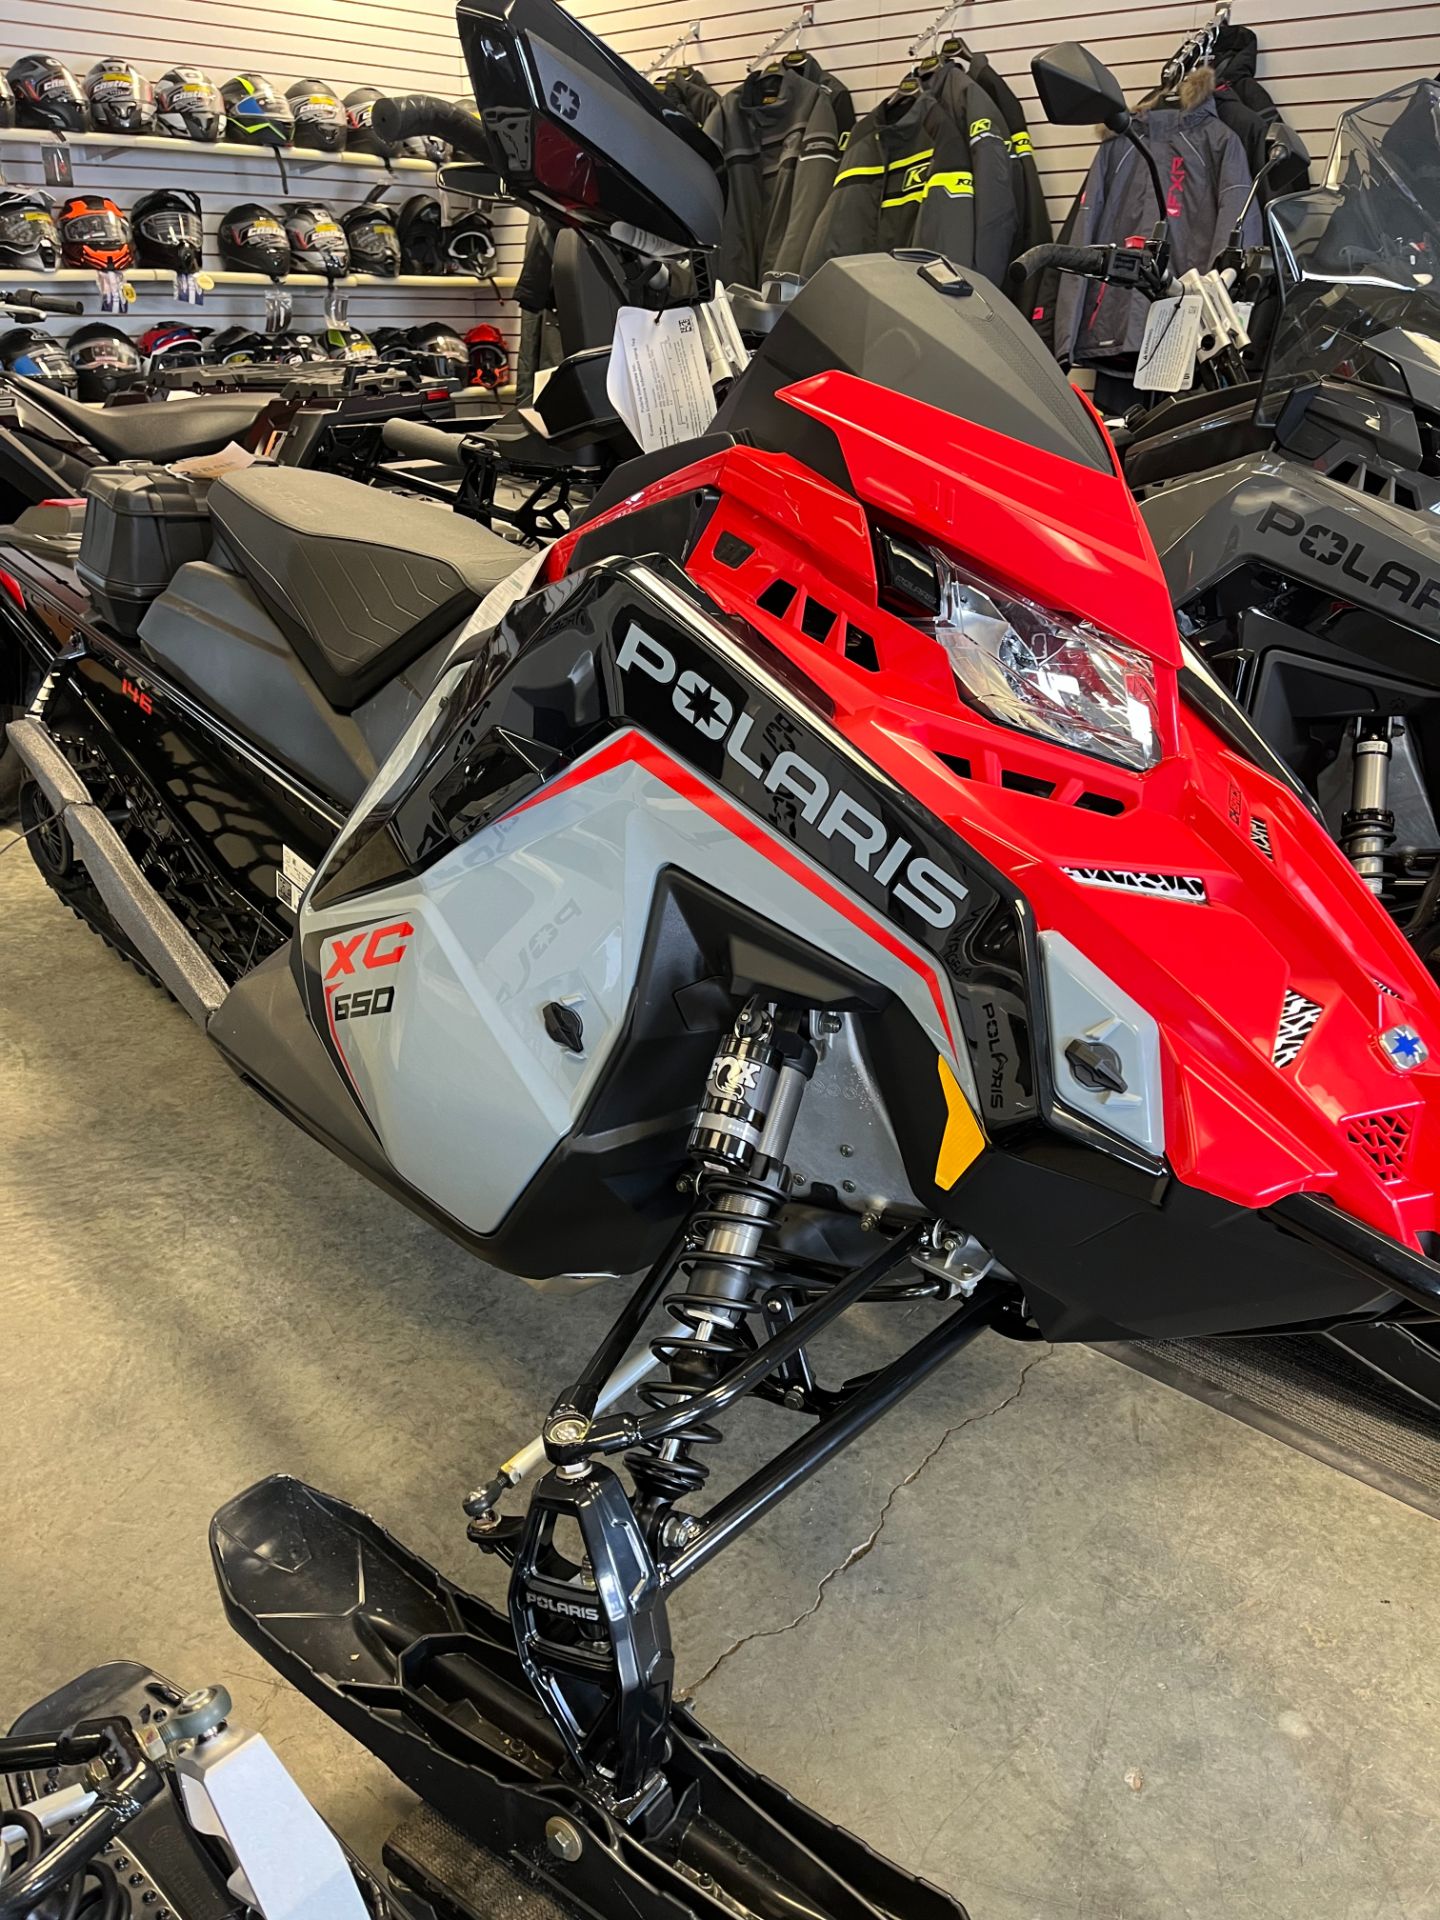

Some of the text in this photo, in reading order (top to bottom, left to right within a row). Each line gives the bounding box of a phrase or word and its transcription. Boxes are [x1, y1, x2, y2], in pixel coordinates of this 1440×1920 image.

[122, 678, 153, 716] 146
[615, 623, 969, 929] POLARIS
[323, 921, 415, 981] XC
[334, 986, 395, 1022] 650
[526, 1591, 600, 1621] POLARIS
